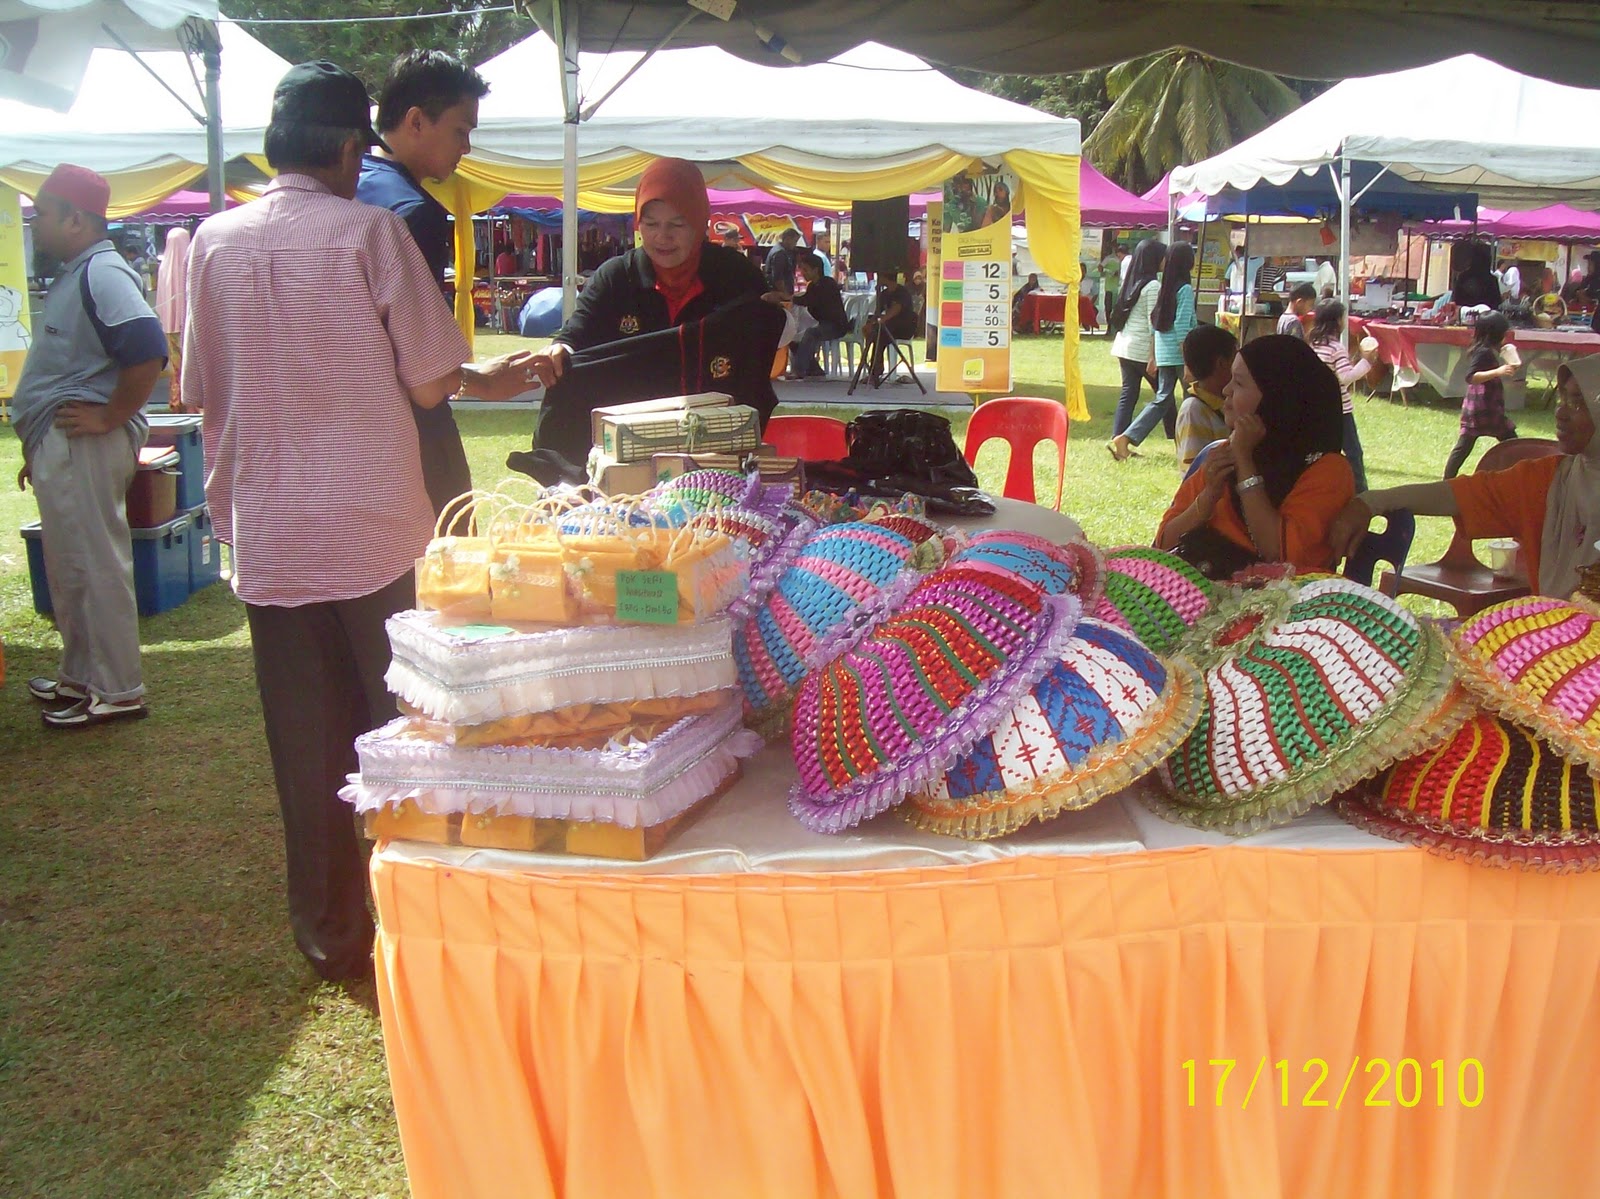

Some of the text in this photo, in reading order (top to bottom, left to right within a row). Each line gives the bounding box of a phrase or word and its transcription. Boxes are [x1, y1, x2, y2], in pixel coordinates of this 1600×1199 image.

[981, 263, 1001, 279] 12
[988, 284, 1000, 300] 5
[984, 316, 999, 326] 50
[987, 331, 999, 346] 5
